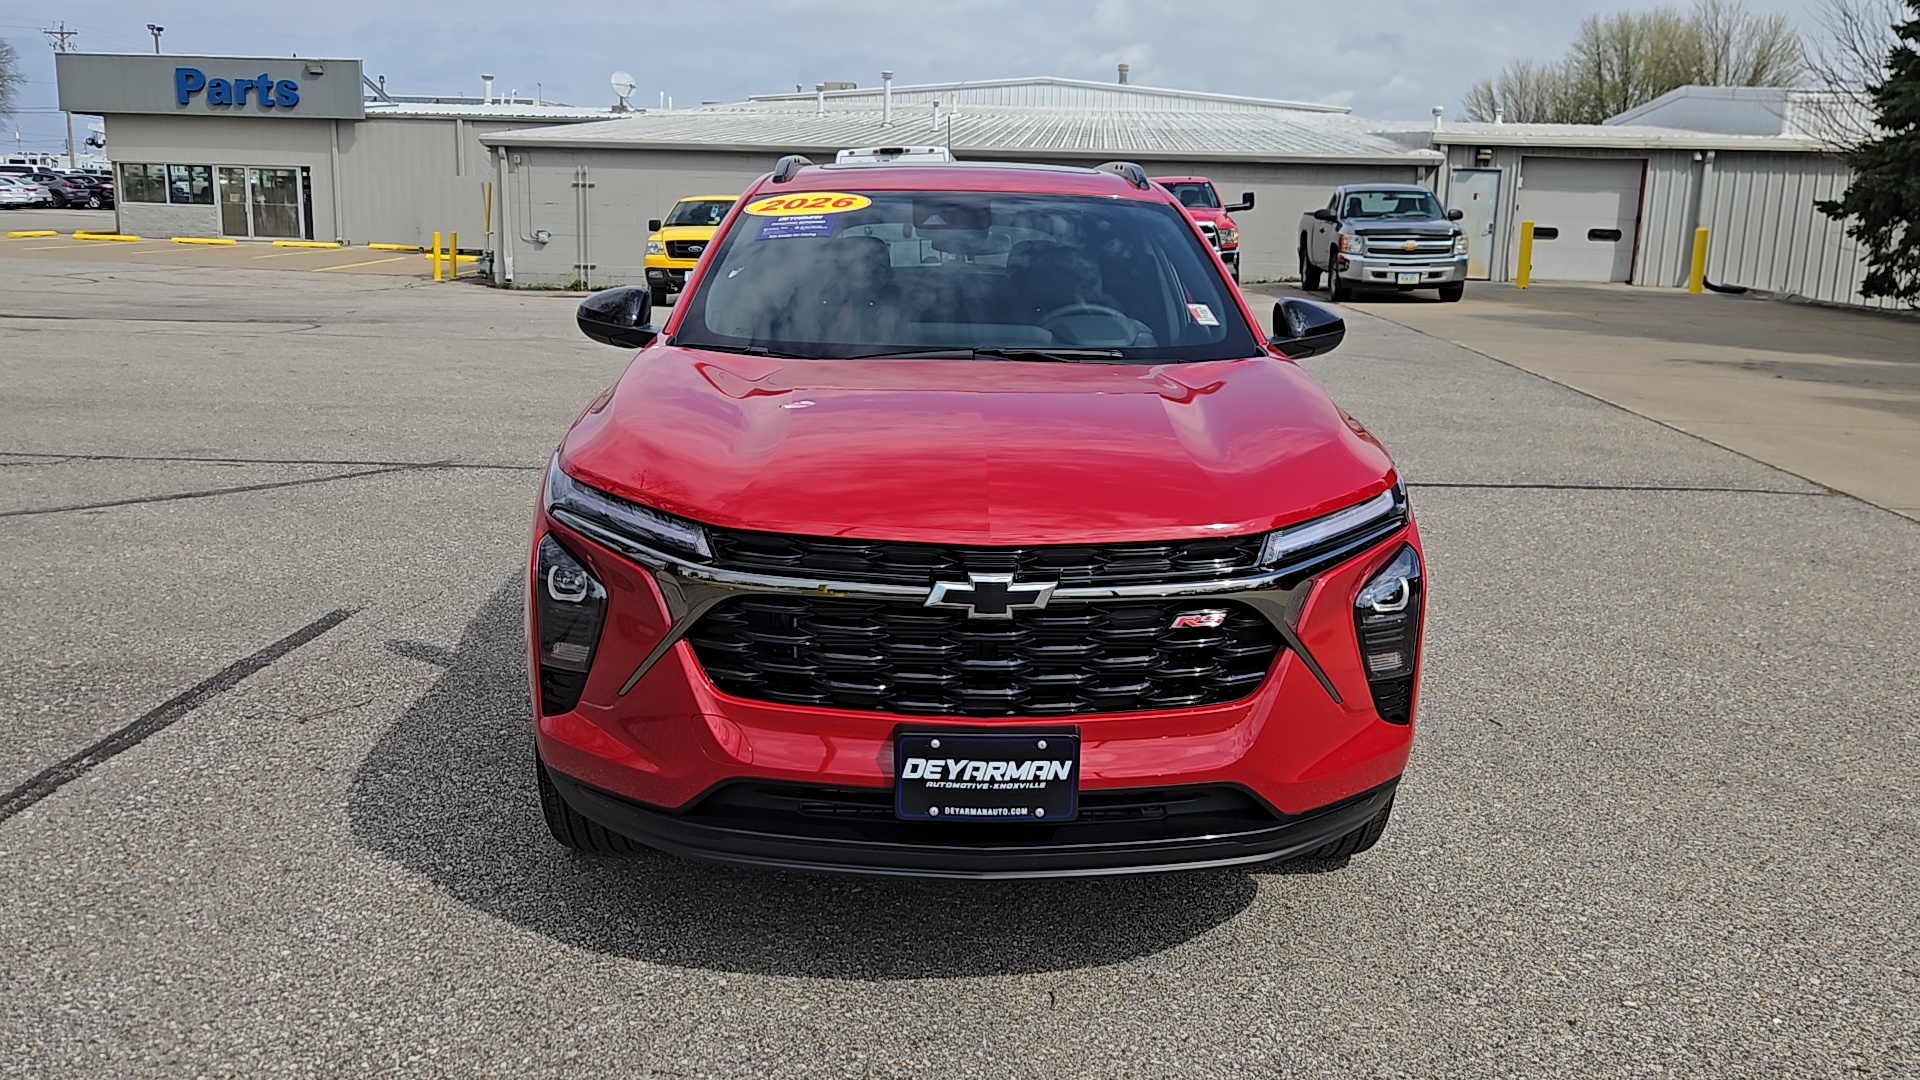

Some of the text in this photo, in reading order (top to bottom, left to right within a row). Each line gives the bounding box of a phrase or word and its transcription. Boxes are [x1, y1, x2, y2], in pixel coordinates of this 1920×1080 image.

[175, 67, 300, 107] Parts
[757, 197, 857, 212] 2026
[1171, 613, 1227, 629] RS
[902, 758, 1073, 781] DEYARMAN
[944, 806, 1028, 816] DEYARMANAUTO.COM
